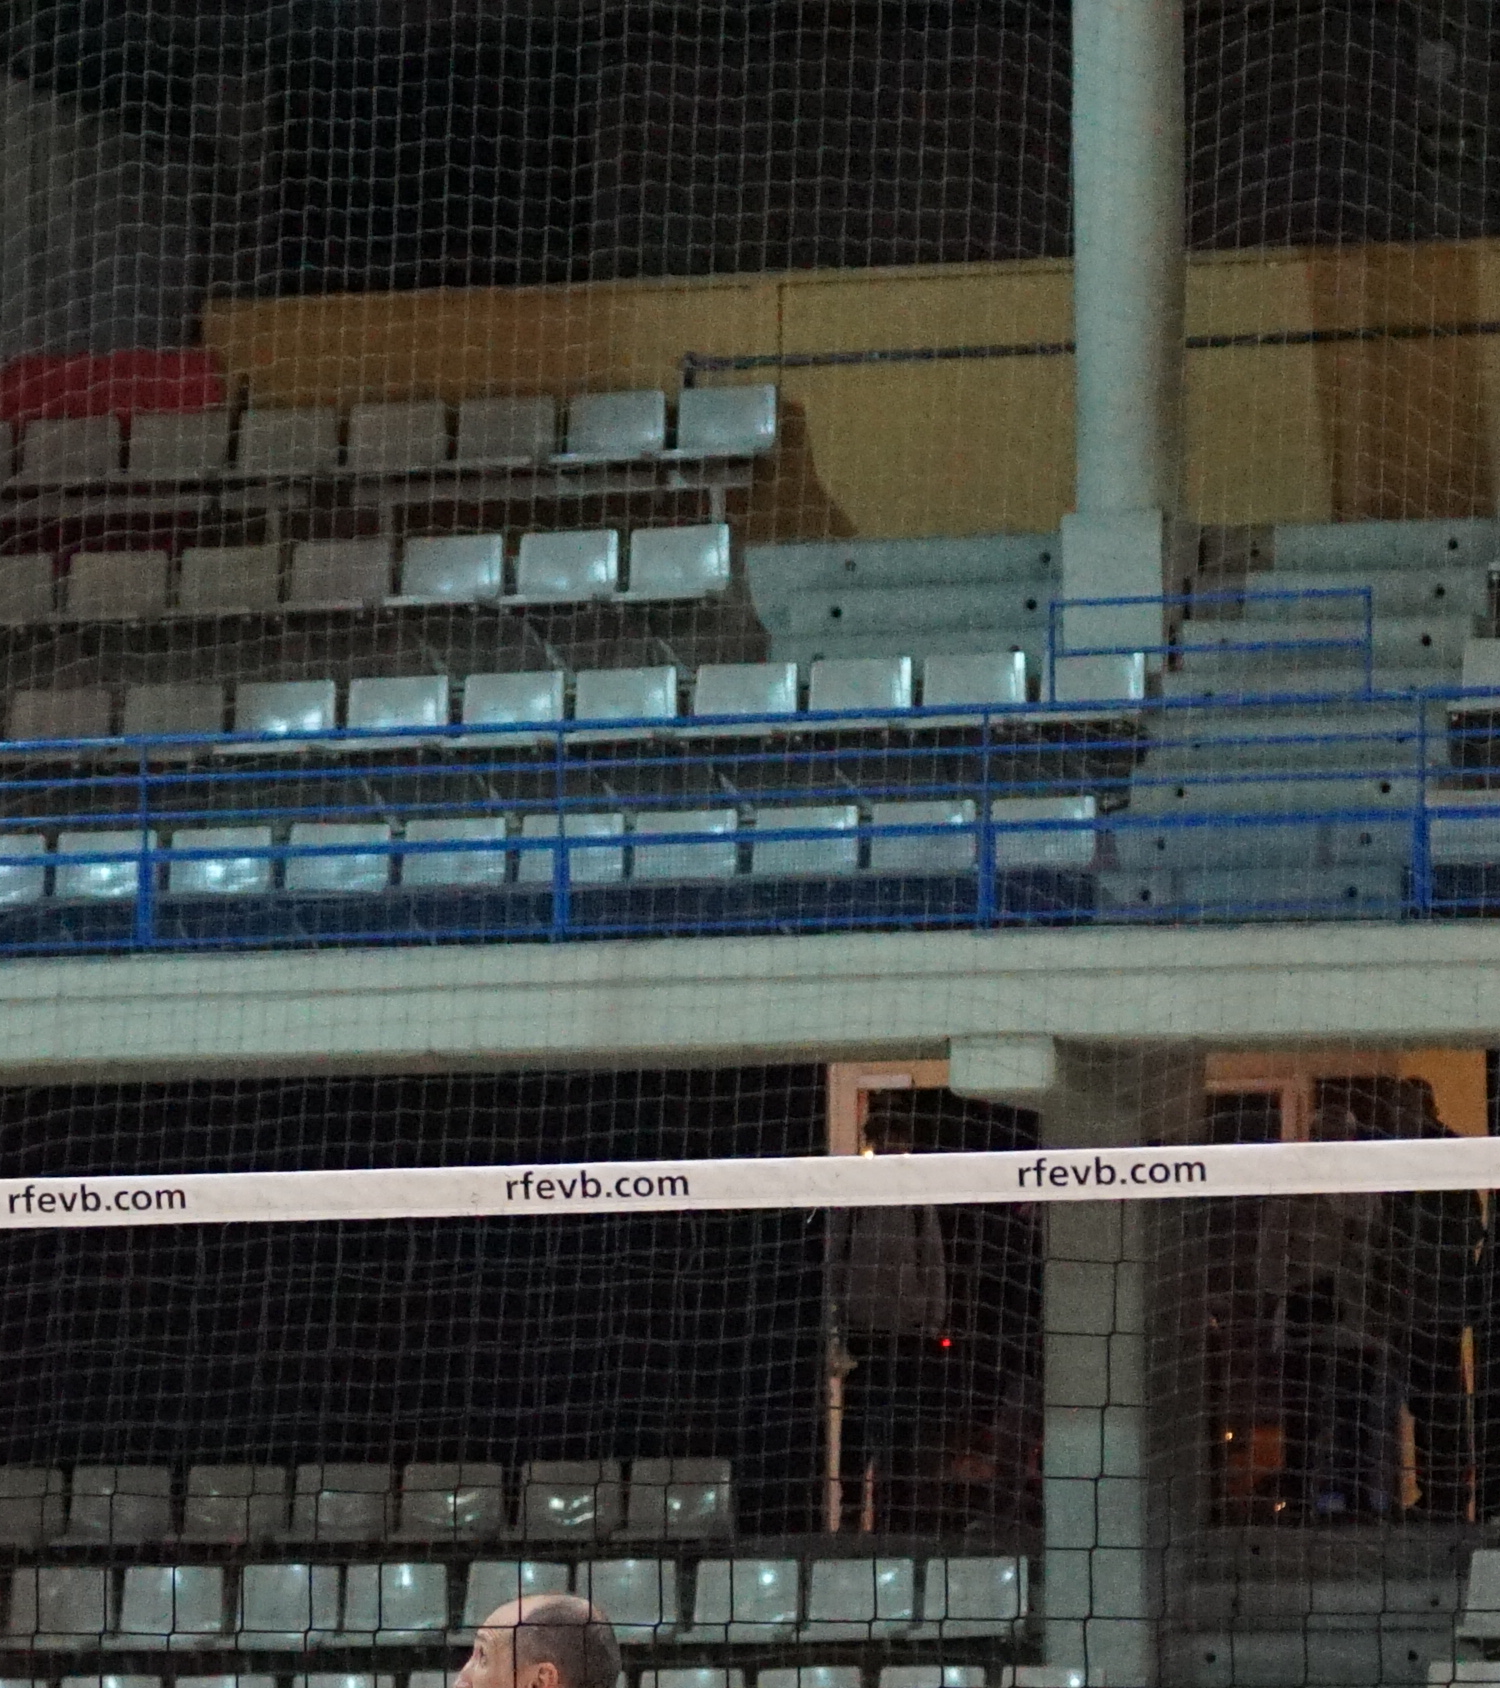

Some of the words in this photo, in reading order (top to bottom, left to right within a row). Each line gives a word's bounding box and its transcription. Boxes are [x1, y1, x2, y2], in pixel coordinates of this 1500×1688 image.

[506, 1169, 689, 1200] rfevb.com
[1018, 1156, 1206, 1187] rfevb.com
[8, 1184, 186, 1214] rfevb.com
